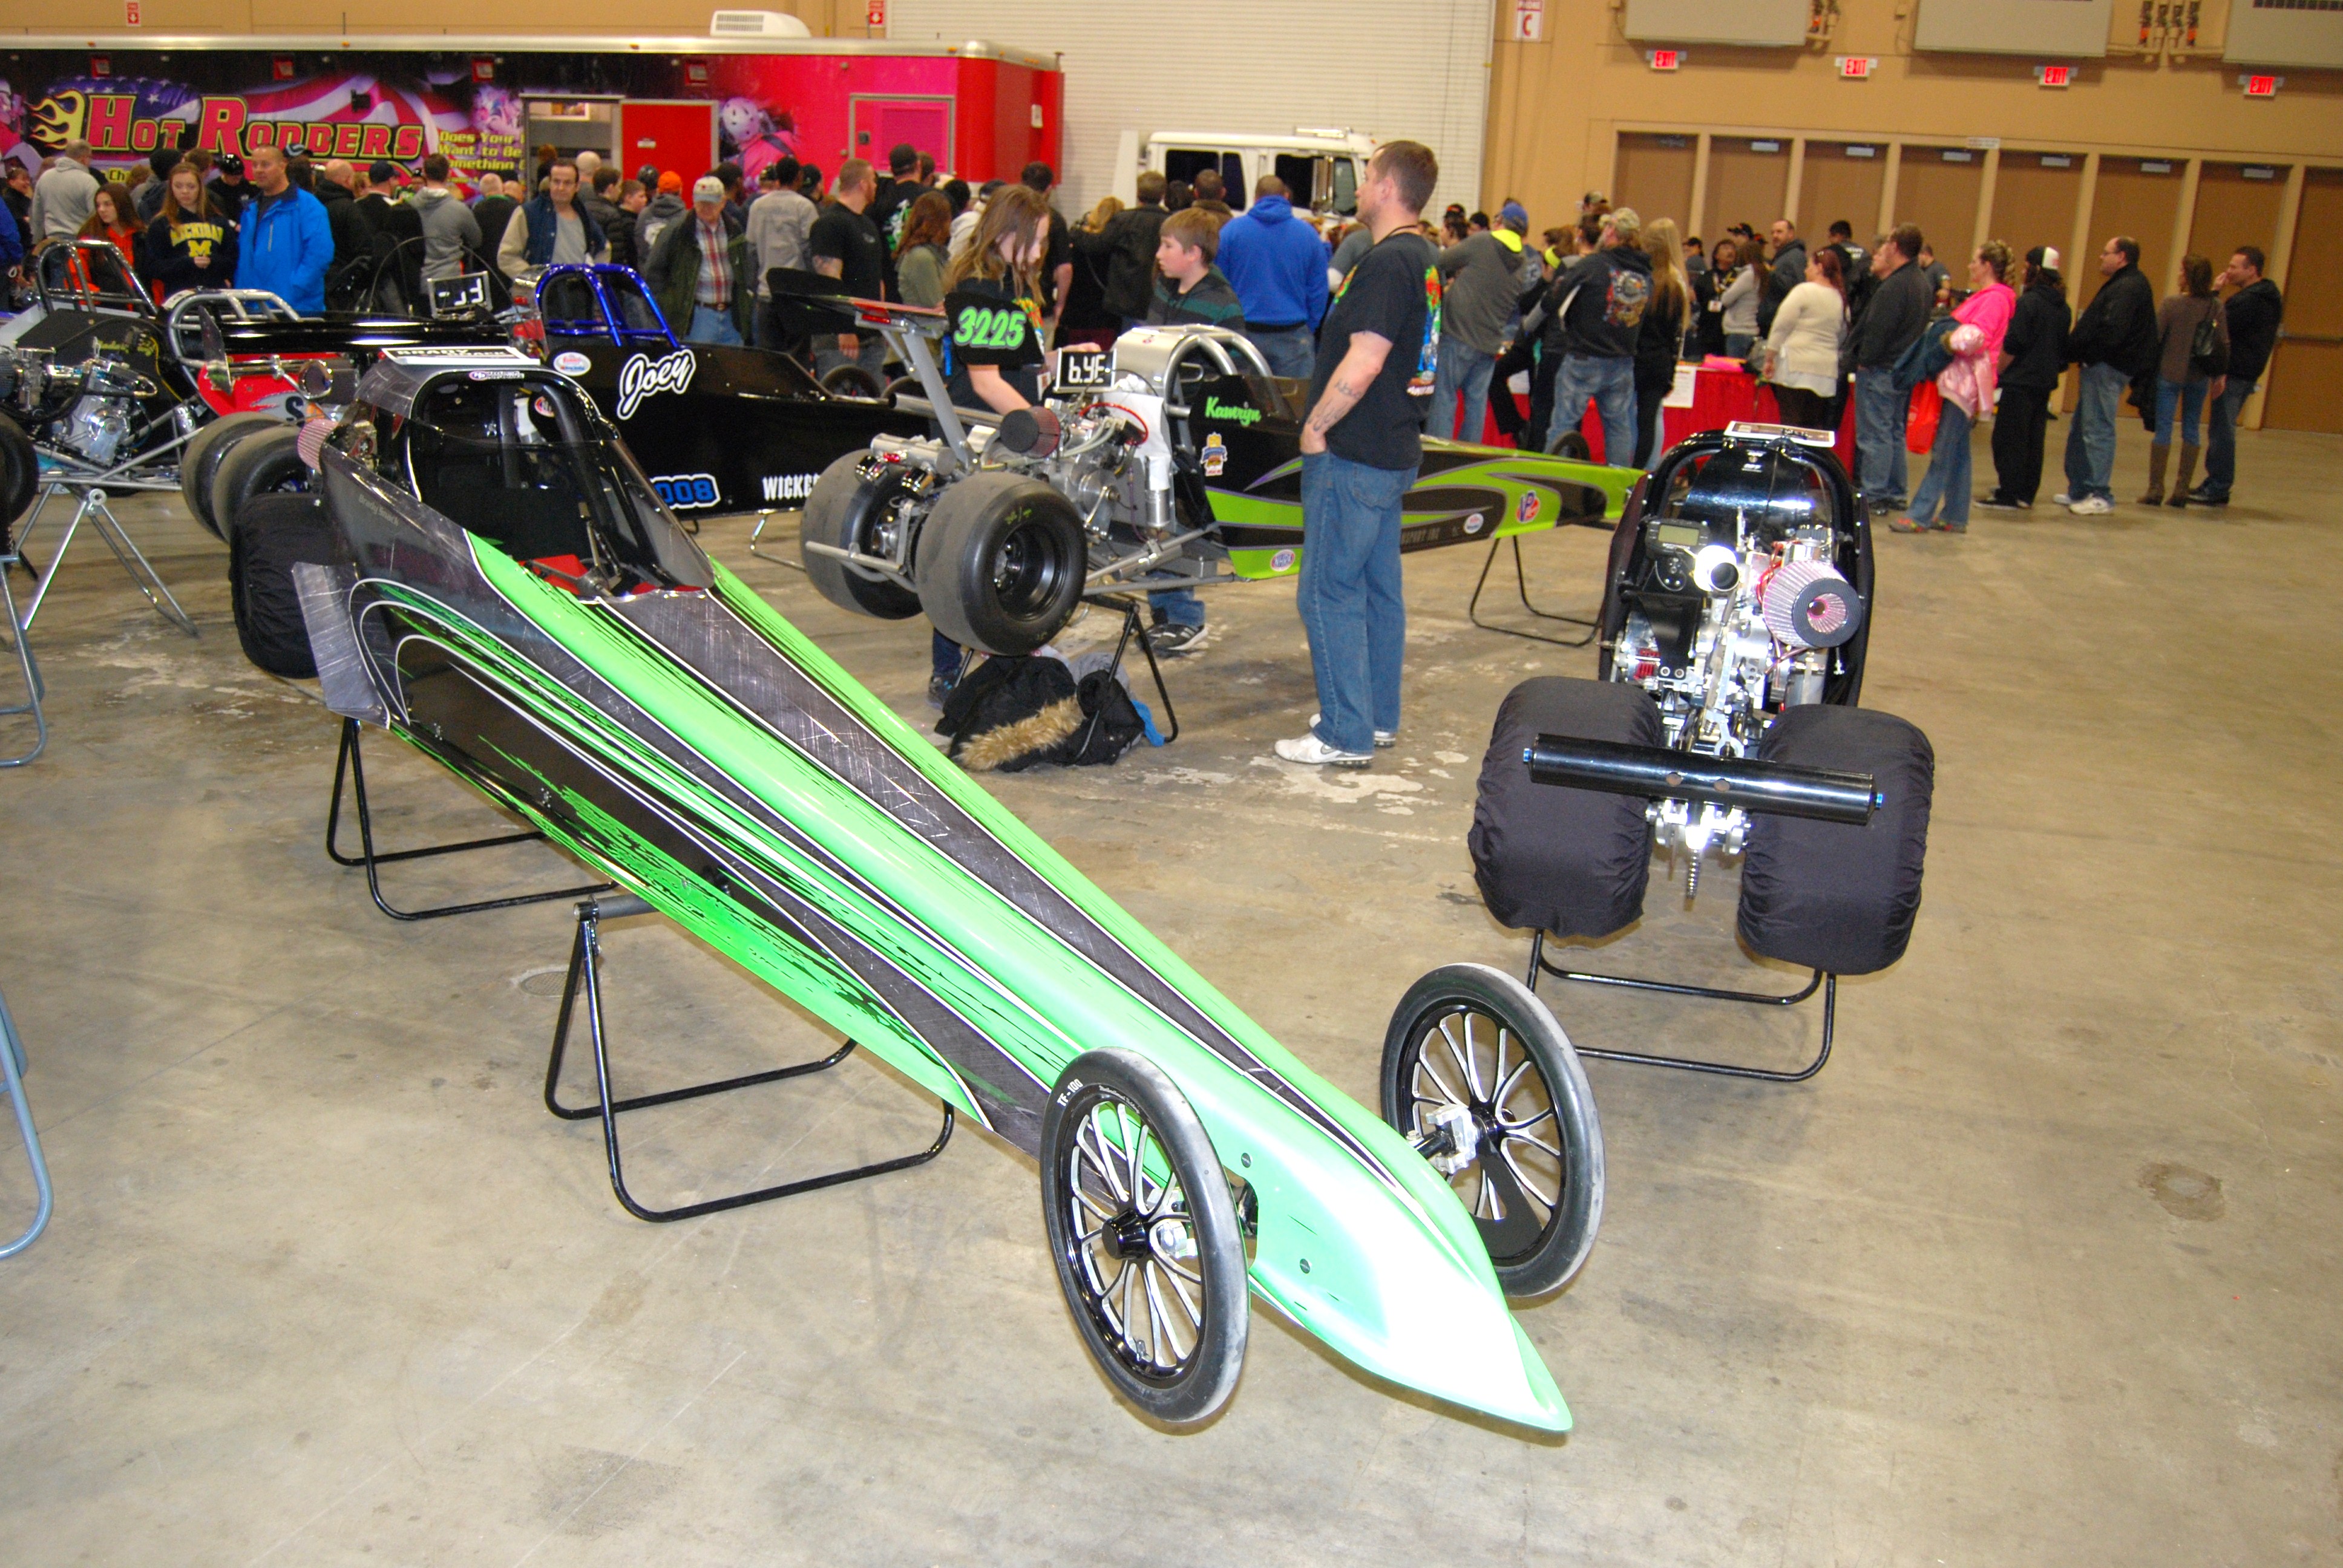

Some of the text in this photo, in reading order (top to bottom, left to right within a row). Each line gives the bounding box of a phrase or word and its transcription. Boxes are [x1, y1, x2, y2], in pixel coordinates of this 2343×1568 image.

[1656, 50, 1677, 69] EXIT
[1846, 58, 1868, 76] EXIT
[2045, 67, 2068, 85] EXIT
[2249, 76, 2275, 94] EXIT
[440, 131, 476, 143] Does
[480, 131, 514, 144] Your
[438, 143, 476, 155] Want
[482, 146, 499, 157] to
[954, 307, 1026, 349] 3225
[620, 351, 693, 417] Joey
